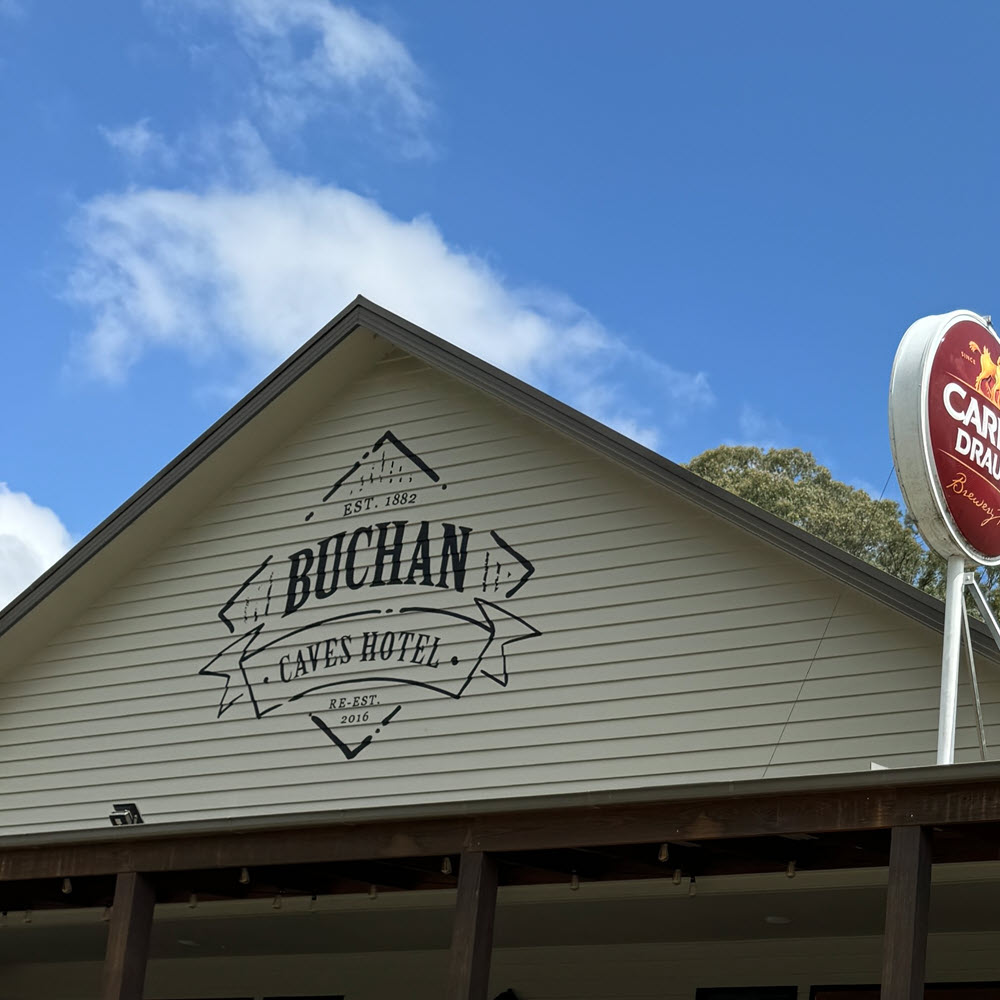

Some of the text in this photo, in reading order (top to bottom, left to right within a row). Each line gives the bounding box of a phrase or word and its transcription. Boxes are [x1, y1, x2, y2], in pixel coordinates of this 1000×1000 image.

[343, 493, 417, 516] EST. 1882
[946, 472, 996, 526] Brewery
[281, 520, 473, 618] BUCHAN
[279, 631, 441, 683] CAVES HOTEL
[328, 694, 380, 710] RE-EST.
[340, 713, 369, 724] 2016
